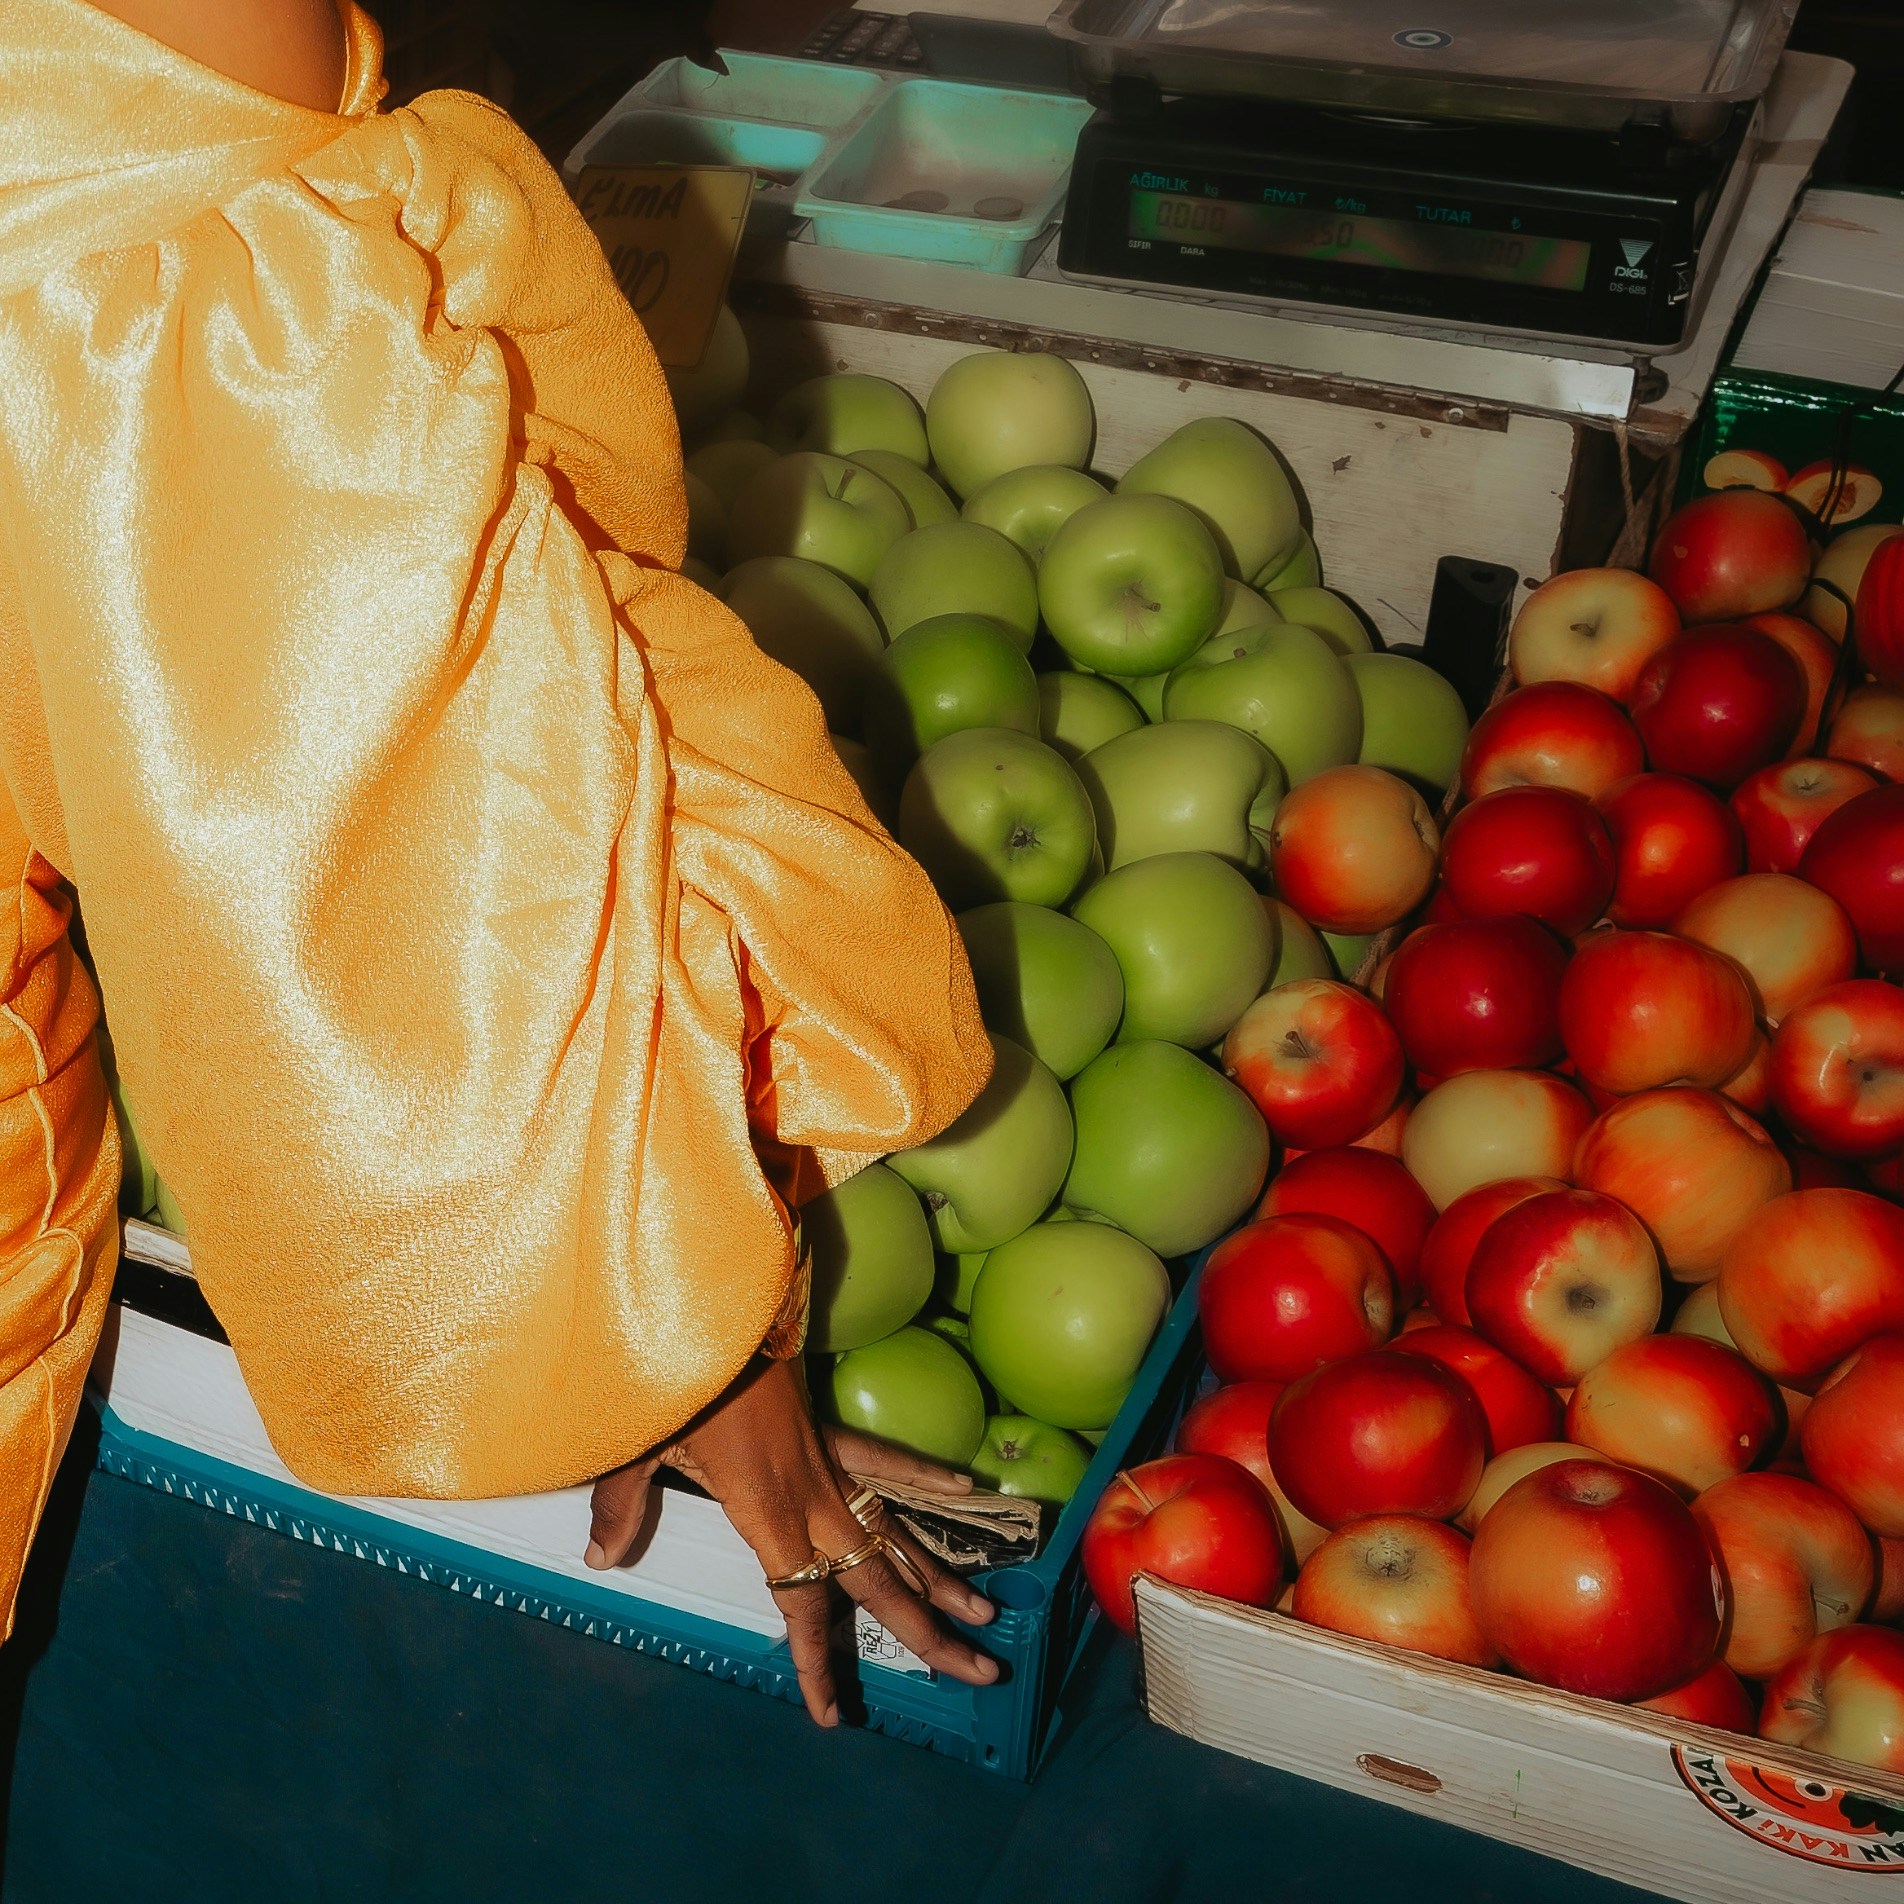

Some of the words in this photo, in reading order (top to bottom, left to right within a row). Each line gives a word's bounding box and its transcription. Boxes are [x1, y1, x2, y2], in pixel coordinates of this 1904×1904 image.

[1129, 171, 1190, 193] AĞIRLIK
[1414, 203, 1473, 225] TUTAR
[1180, 245, 1205, 257] DARA
[1614, 265, 1645, 279] DIGI
[1609, 282, 1647, 296] DS-685
[1687, 1747, 1757, 1823] KOZA
